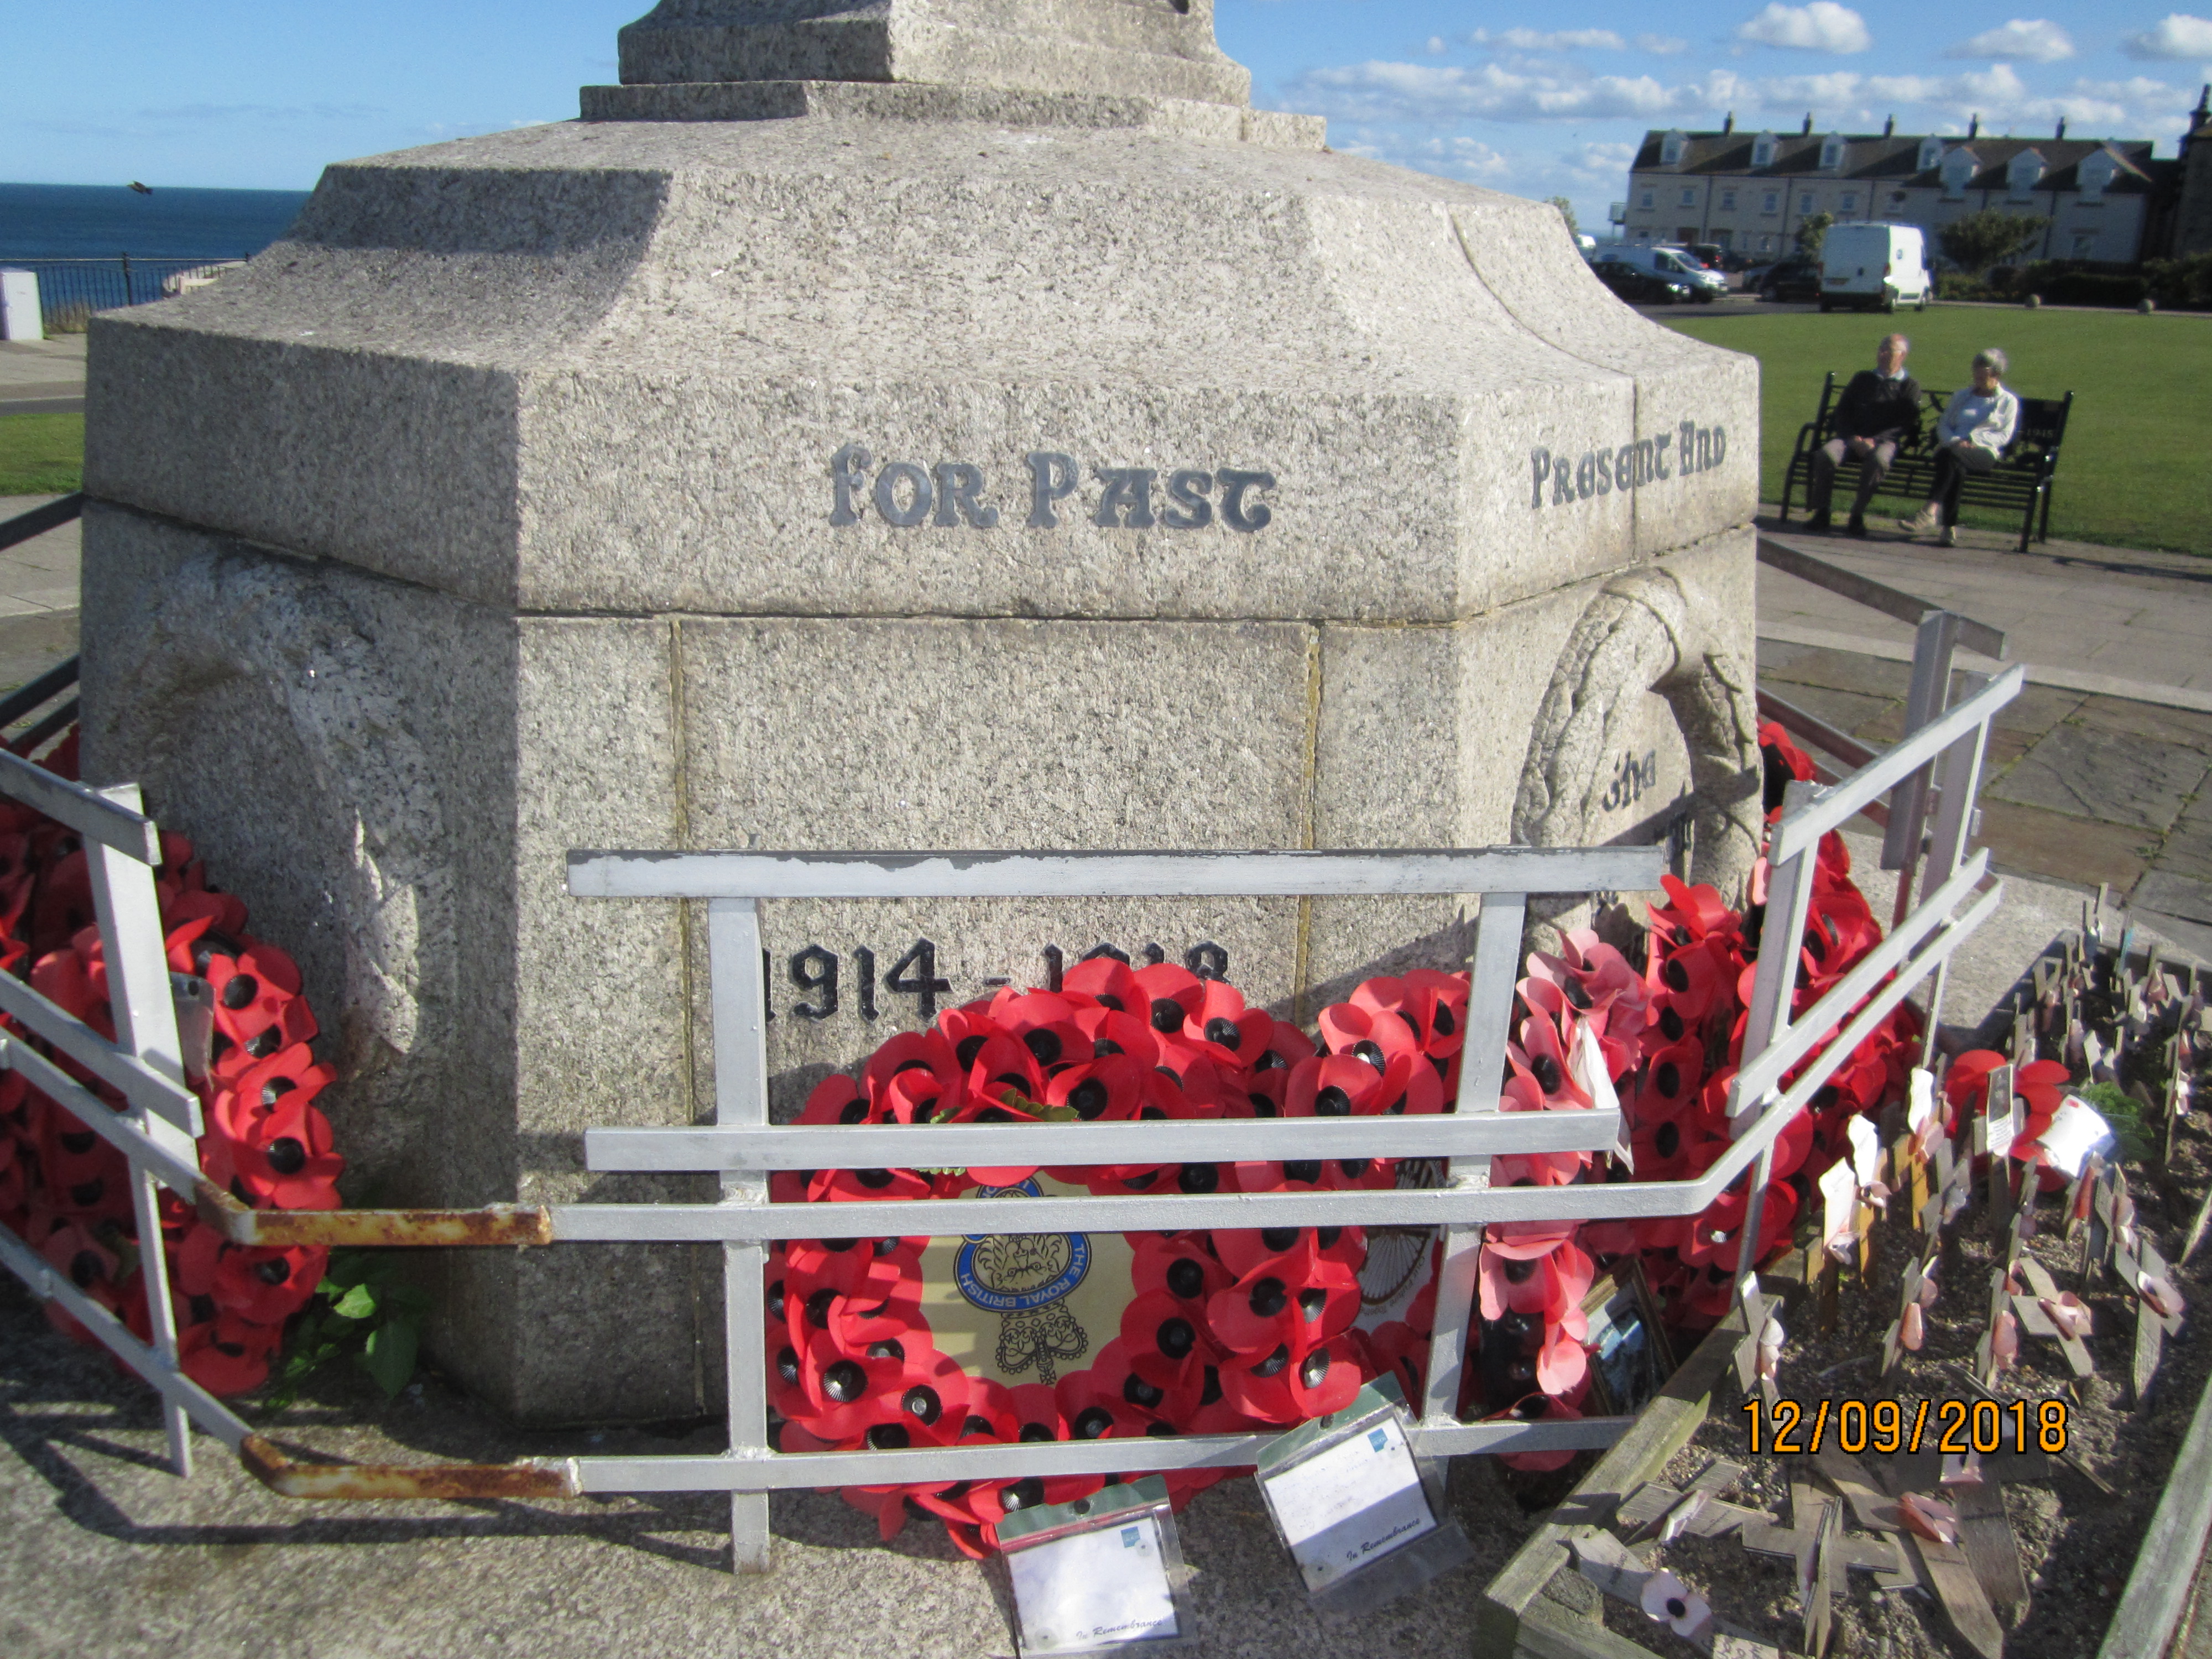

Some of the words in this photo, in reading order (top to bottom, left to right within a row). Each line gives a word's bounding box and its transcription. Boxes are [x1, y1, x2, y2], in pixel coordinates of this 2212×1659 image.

[1069, 1244, 1084, 1277] THE
[961, 1273, 1016, 1307] BRITISH
[1020, 1279, 1071, 1305] ROYAL
[1347, 1551, 1358, 1561] In
[1360, 1518, 1420, 1554] Remembrance
[1076, 1631, 1087, 1640] In
[1092, 1619, 1162, 1637] Remembrance
